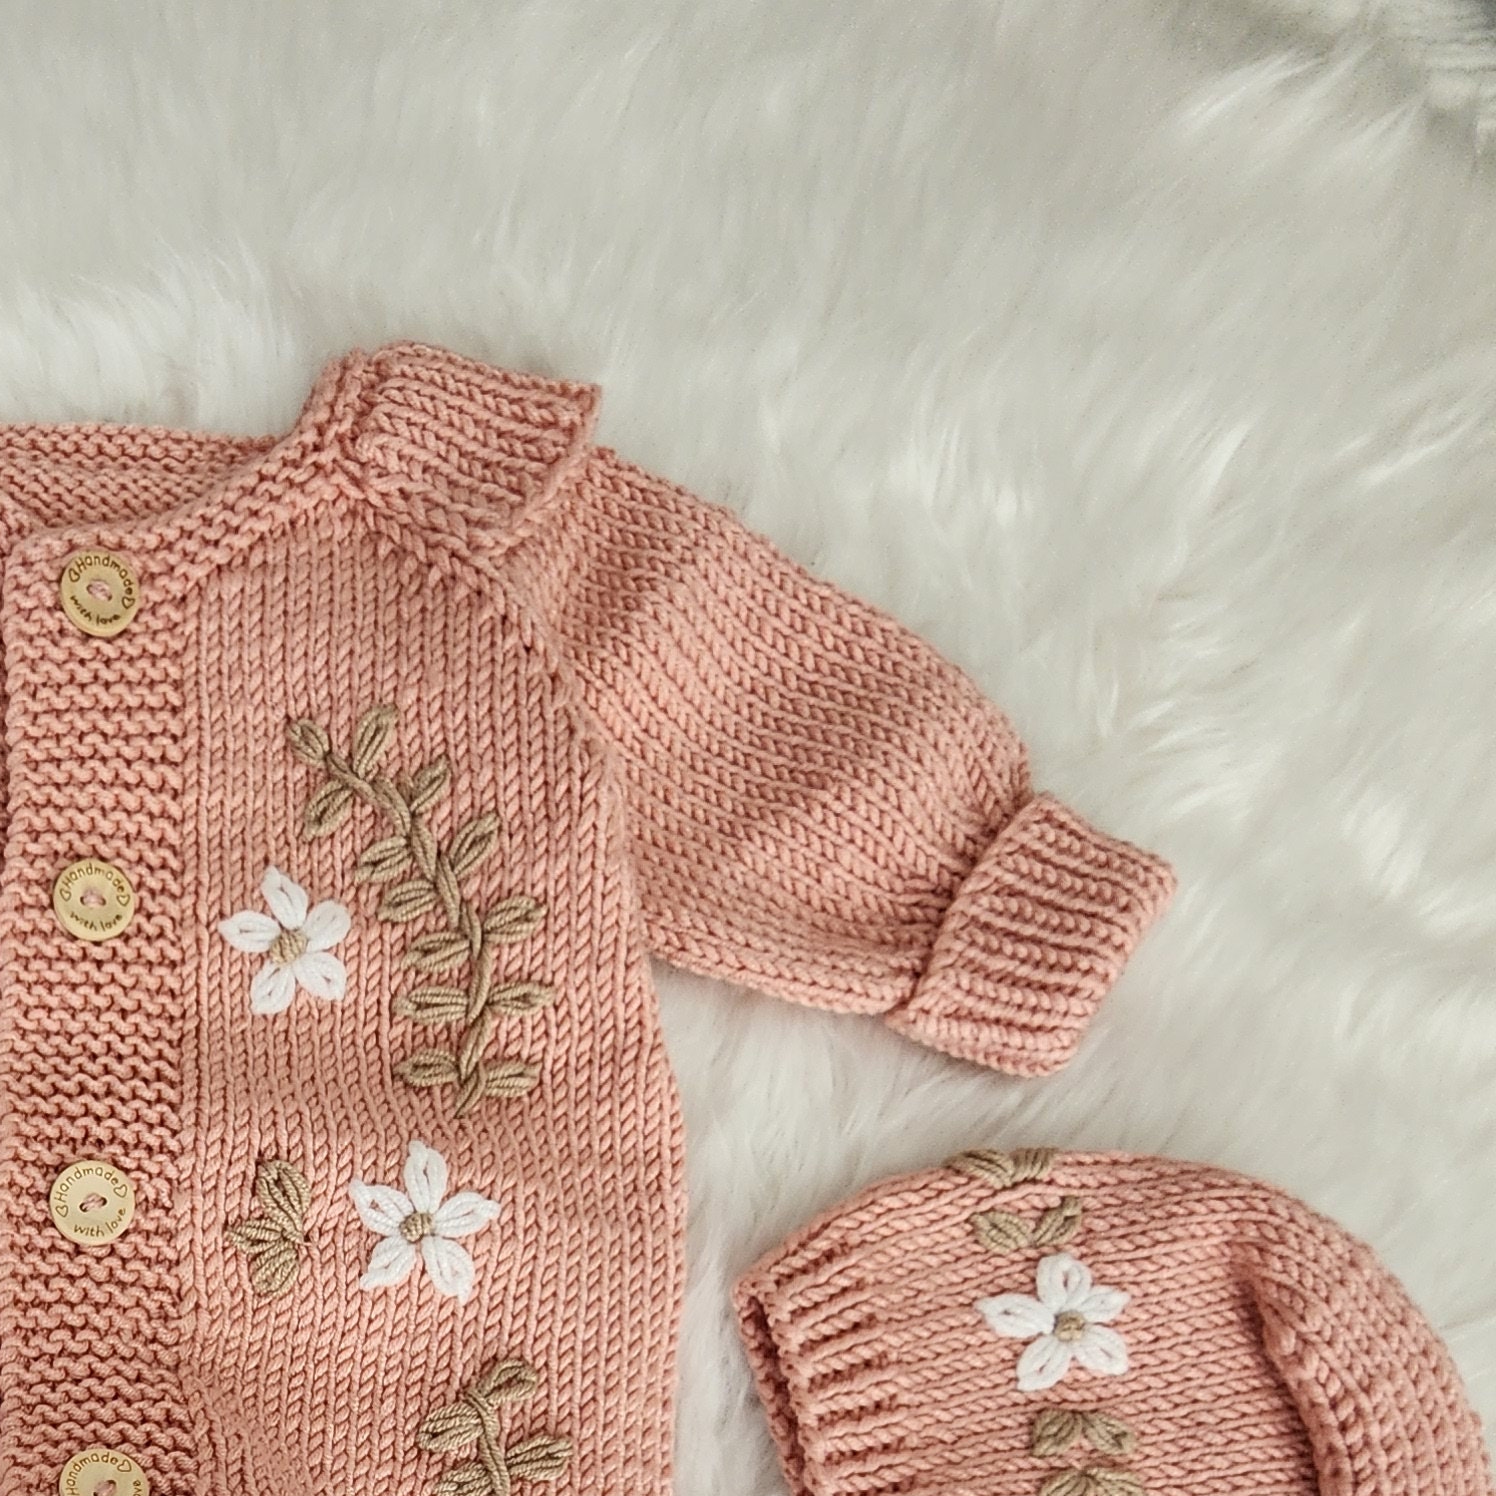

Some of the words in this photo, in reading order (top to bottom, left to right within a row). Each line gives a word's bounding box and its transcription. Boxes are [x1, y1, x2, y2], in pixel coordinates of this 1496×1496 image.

[75, 554, 133, 595] Handmade
[62, 862, 124, 893] Handmade
[54, 1167, 118, 1202] Handmade
[74, 1224, 104, 1237] with
[106, 1208, 126, 1233] love
[66, 1452, 118, 1495] Handmade
